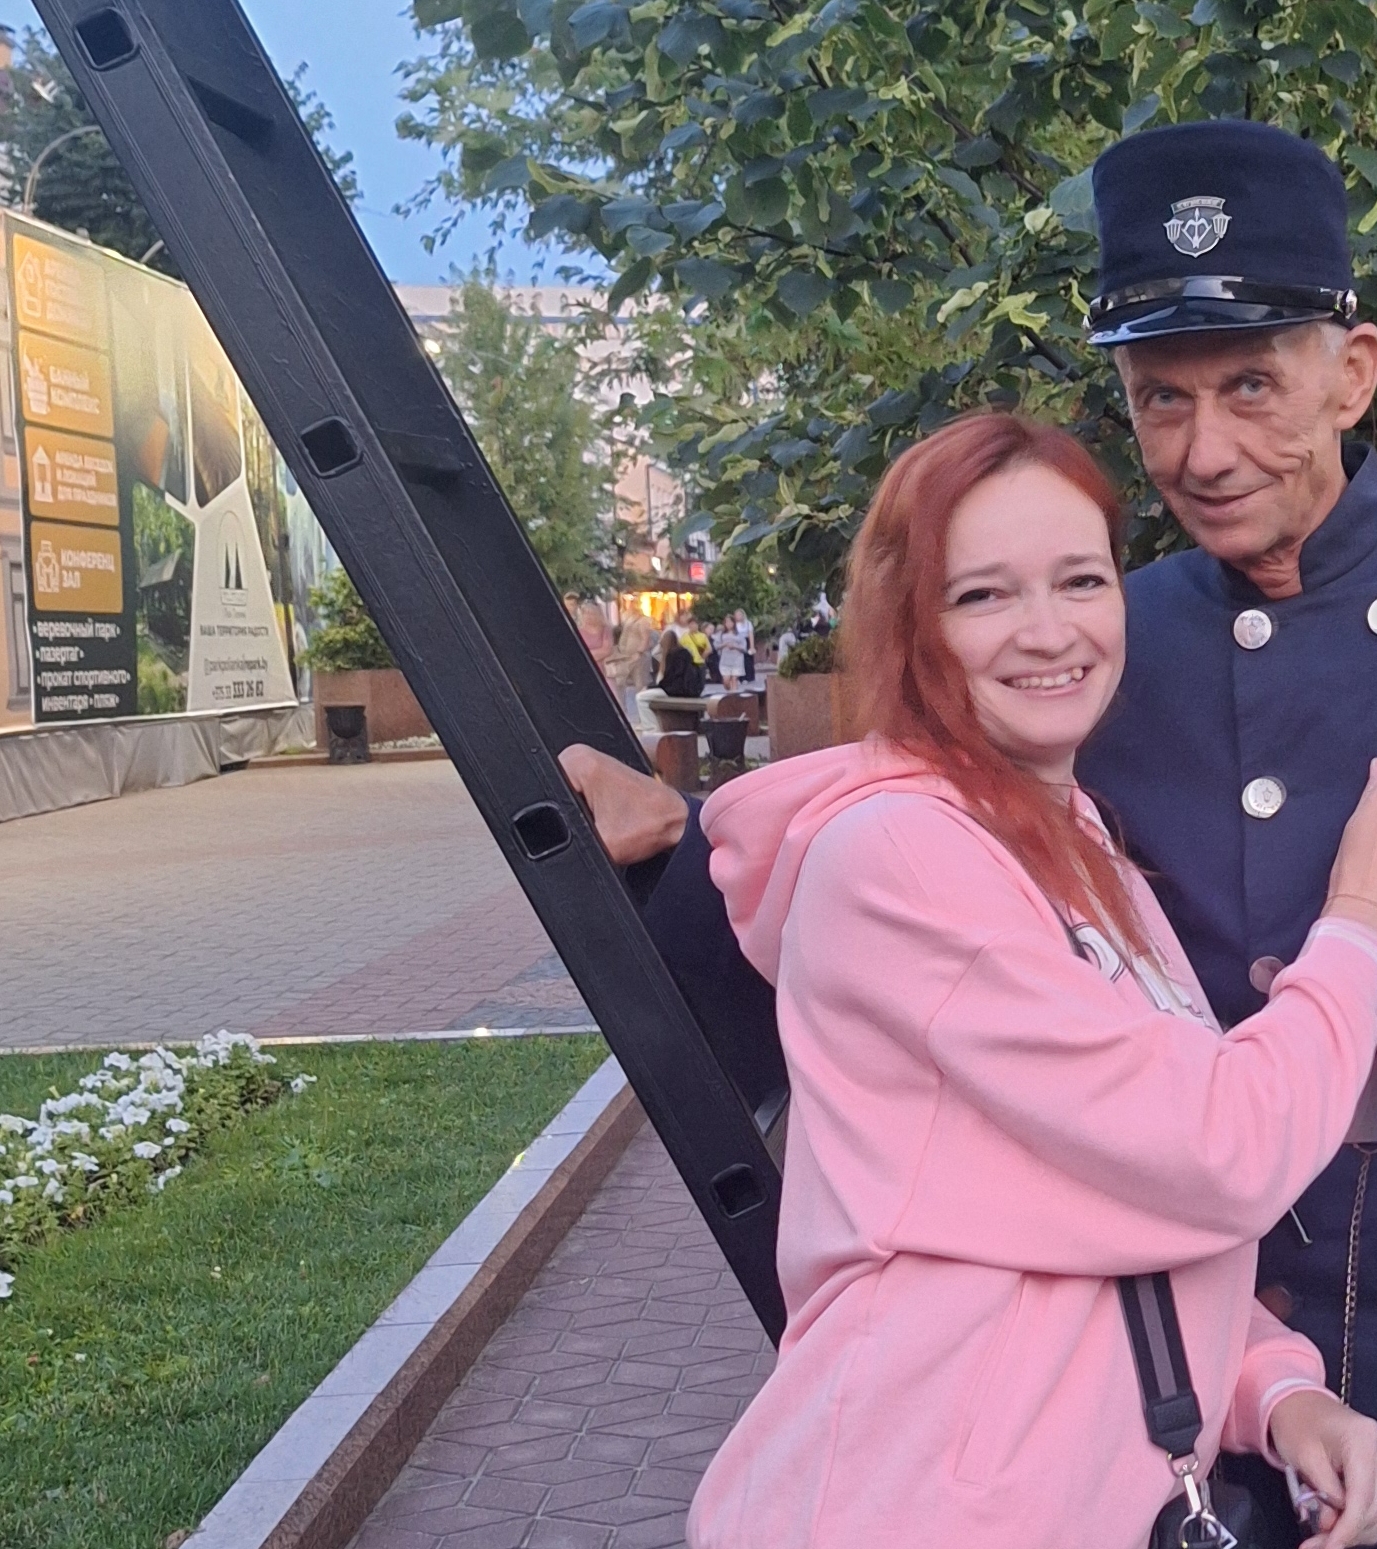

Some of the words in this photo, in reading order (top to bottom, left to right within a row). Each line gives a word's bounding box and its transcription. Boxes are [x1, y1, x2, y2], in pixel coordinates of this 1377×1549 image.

[60, 548, 115, 573] КОНФЕРЕНЦ
[61, 569, 81, 589] ЗАЛ
[94, 622, 117, 642] парк
[41, 670, 73, 691] прокат
